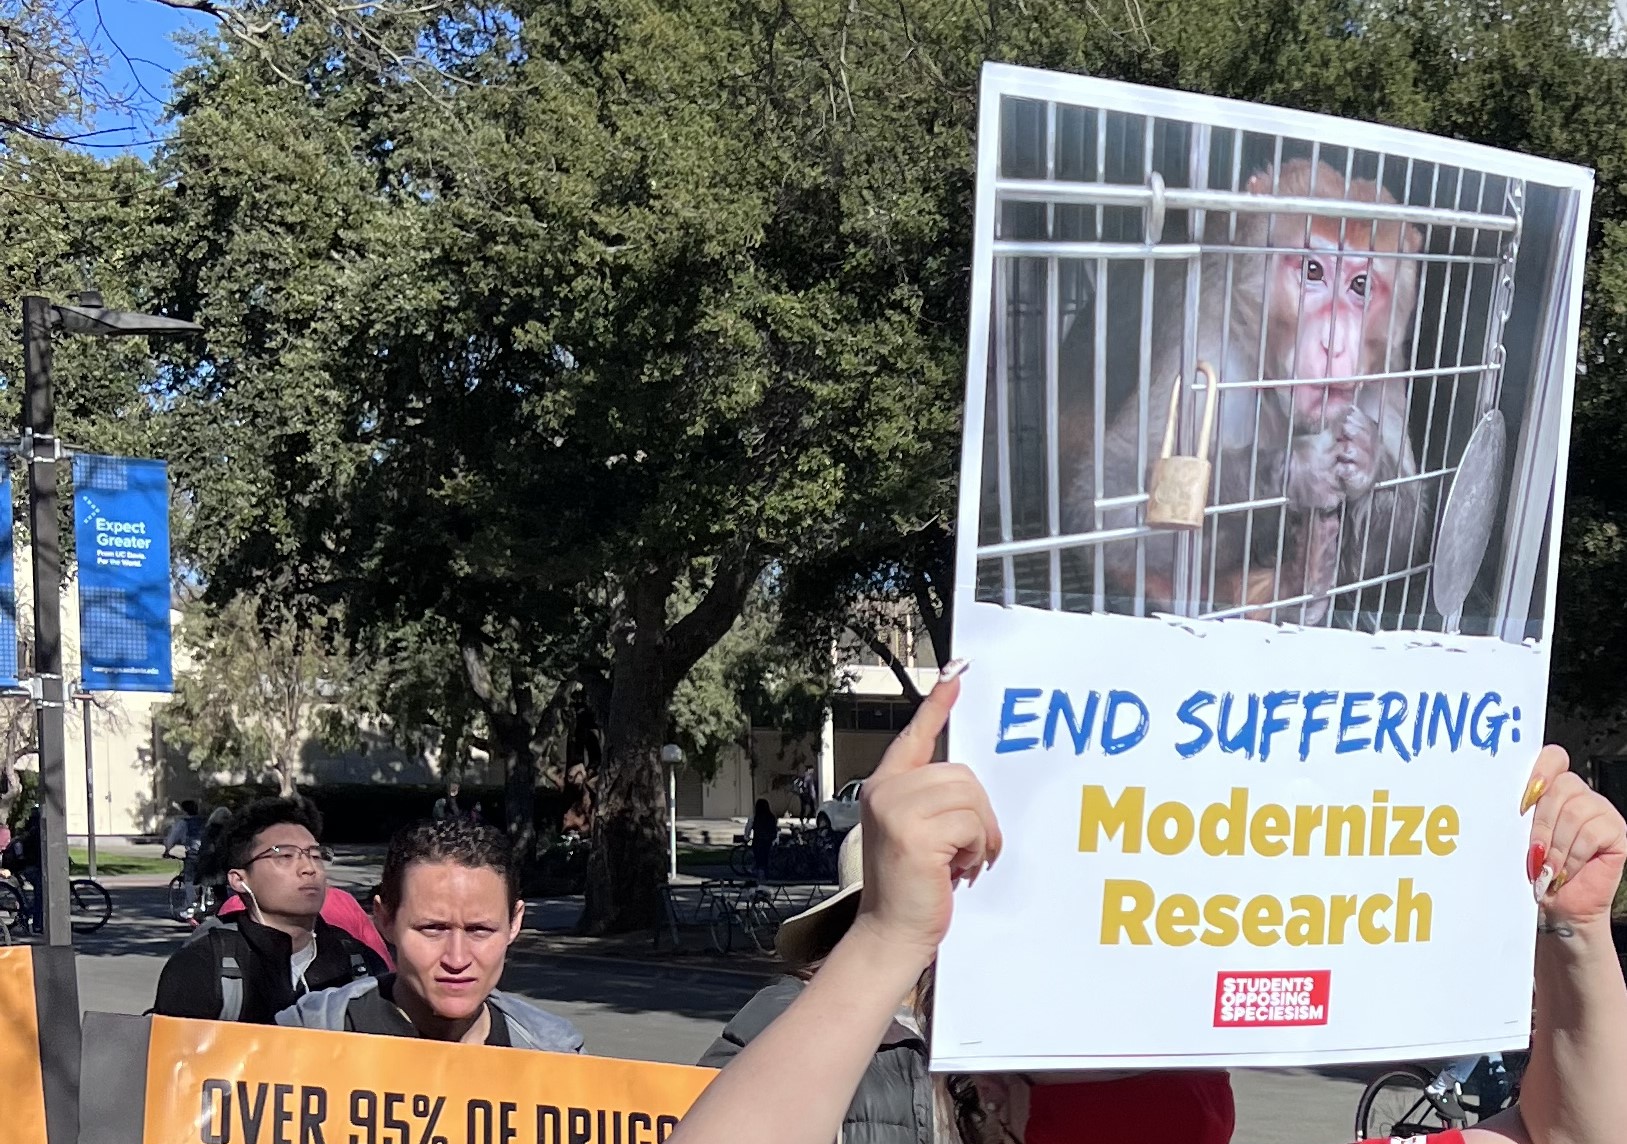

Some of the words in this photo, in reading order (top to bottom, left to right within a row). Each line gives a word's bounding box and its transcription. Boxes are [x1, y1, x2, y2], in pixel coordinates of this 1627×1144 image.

[96, 517, 146, 534] Expect
[97, 533, 151, 549] Greater
[995, 688, 1150, 756] END
[1175, 690, 1521, 763] SUFFERING:
[1078, 785, 1460, 857] Modernize
[1100, 878, 1432, 947] Research
[1223, 977, 1314, 992] STUDENTS
[1221, 991, 1310, 1007] OPPOSING
[1221, 1005, 1324, 1021] SPECIESISM
